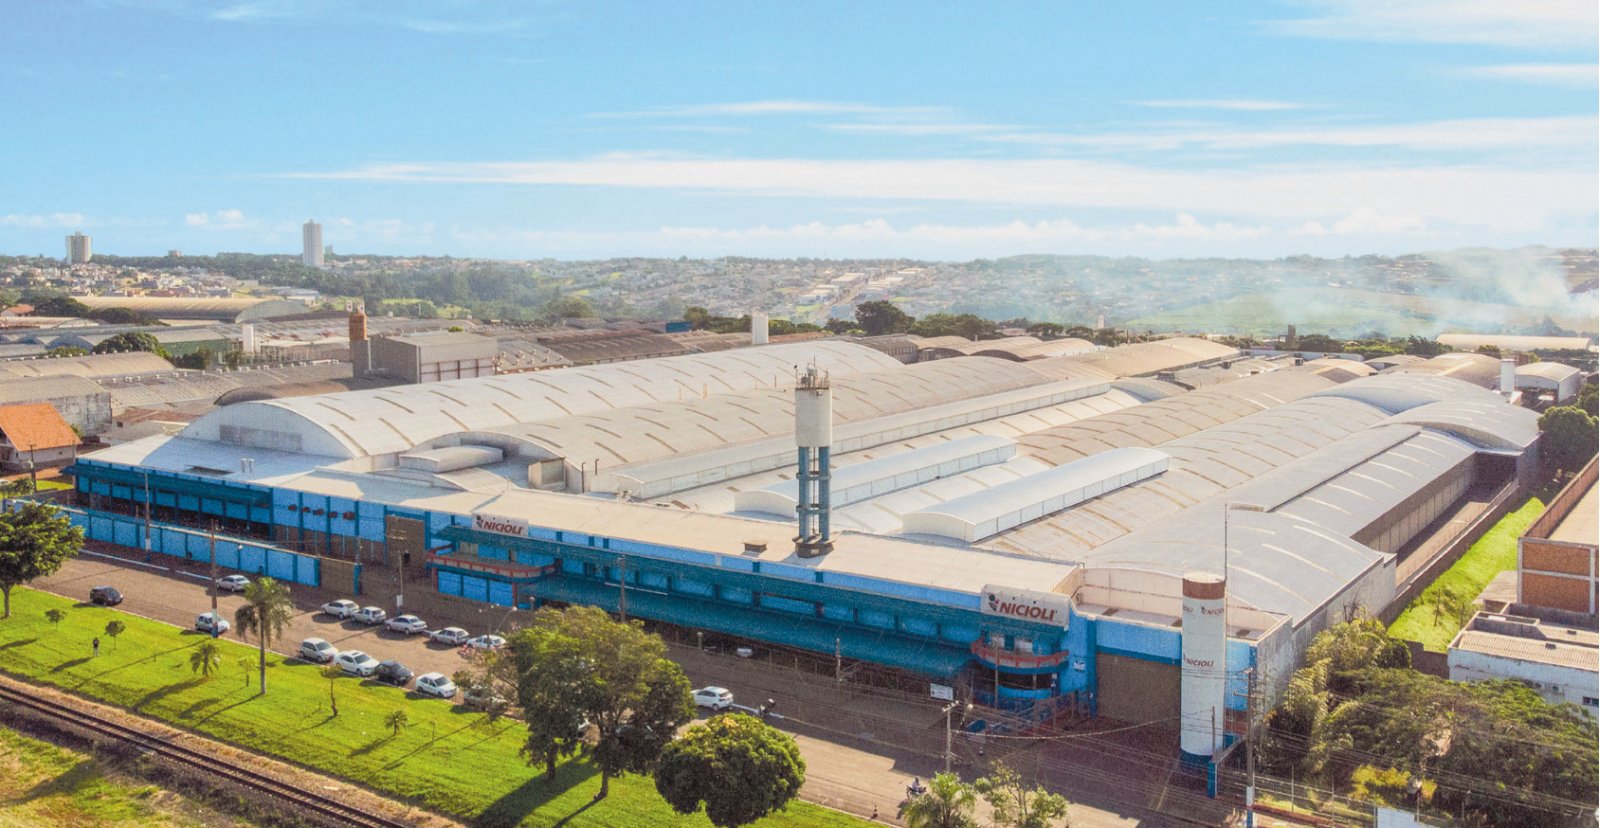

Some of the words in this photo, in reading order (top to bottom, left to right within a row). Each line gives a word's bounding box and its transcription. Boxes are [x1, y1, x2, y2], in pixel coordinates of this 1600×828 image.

[484, 521, 522, 534] NICIOLI
[999, 602, 1054, 621] NICIOLI
[1187, 658, 1214, 667] NICIOLI
